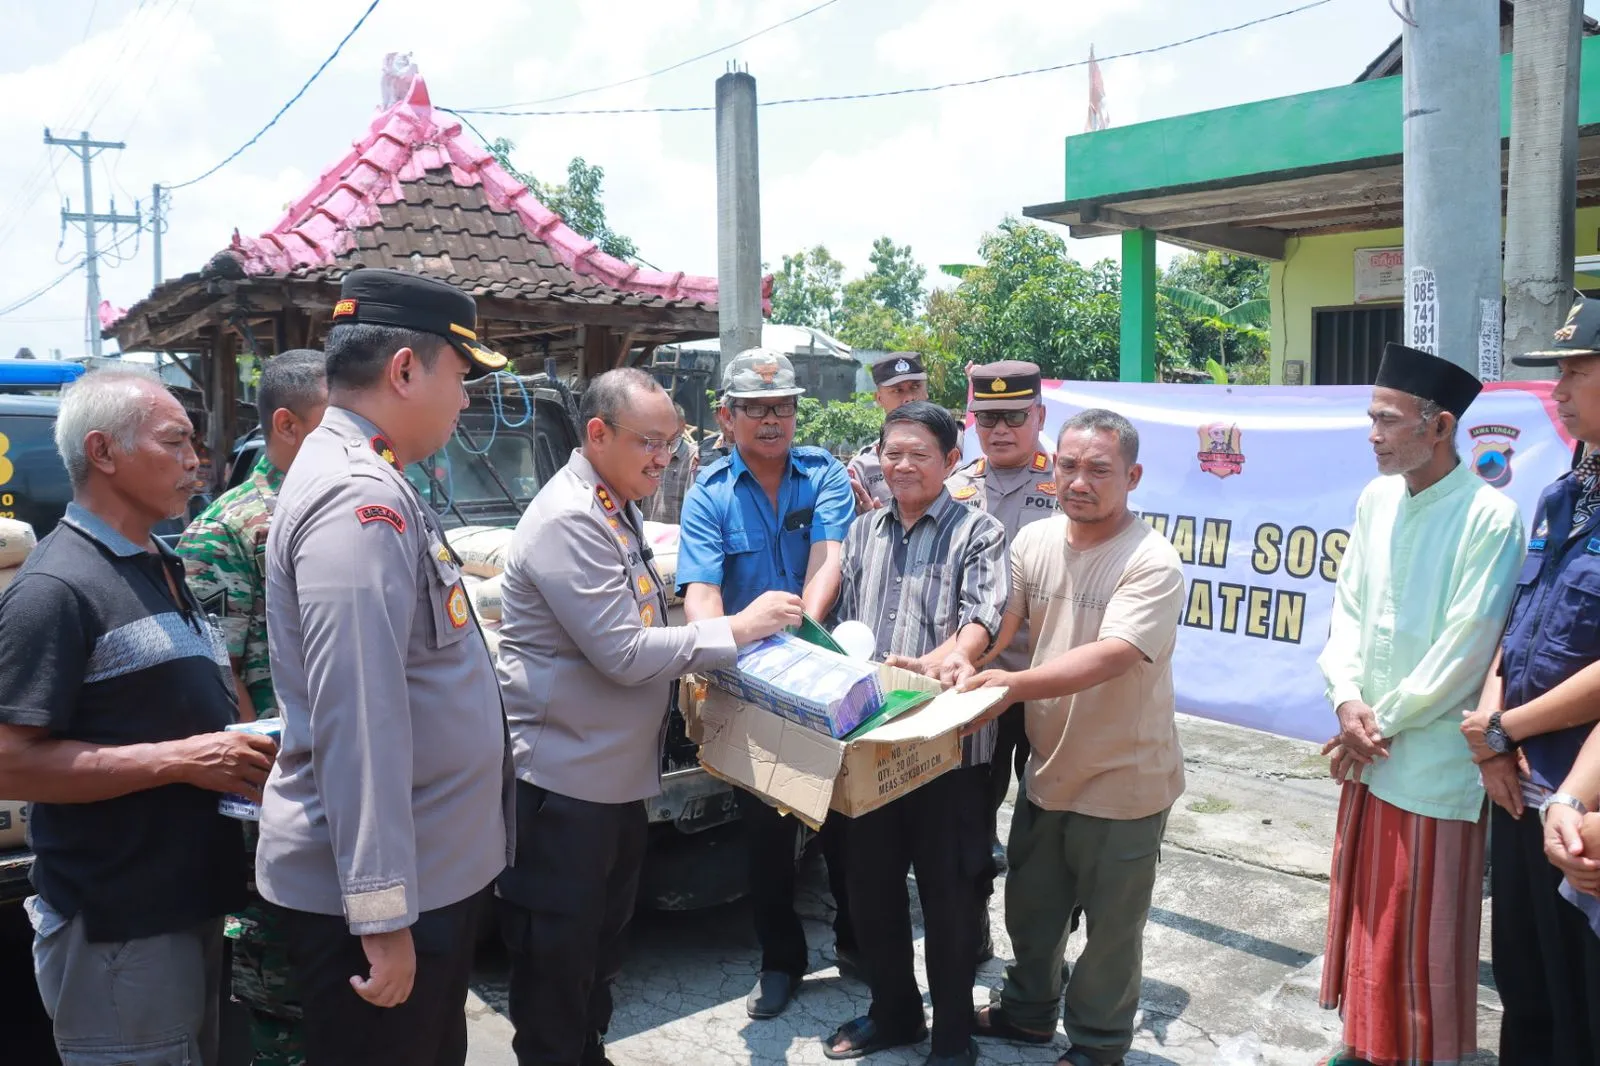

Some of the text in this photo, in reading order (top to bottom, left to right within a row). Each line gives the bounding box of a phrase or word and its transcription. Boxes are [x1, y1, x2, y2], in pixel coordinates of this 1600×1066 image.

[1413, 282, 1435, 302] 085
[1413, 303, 1435, 324] 741
[1413, 324, 1435, 344] 981
[1472, 426, 1517, 436] JAWA TENGAH
[1177, 578, 1306, 644] ATEN
